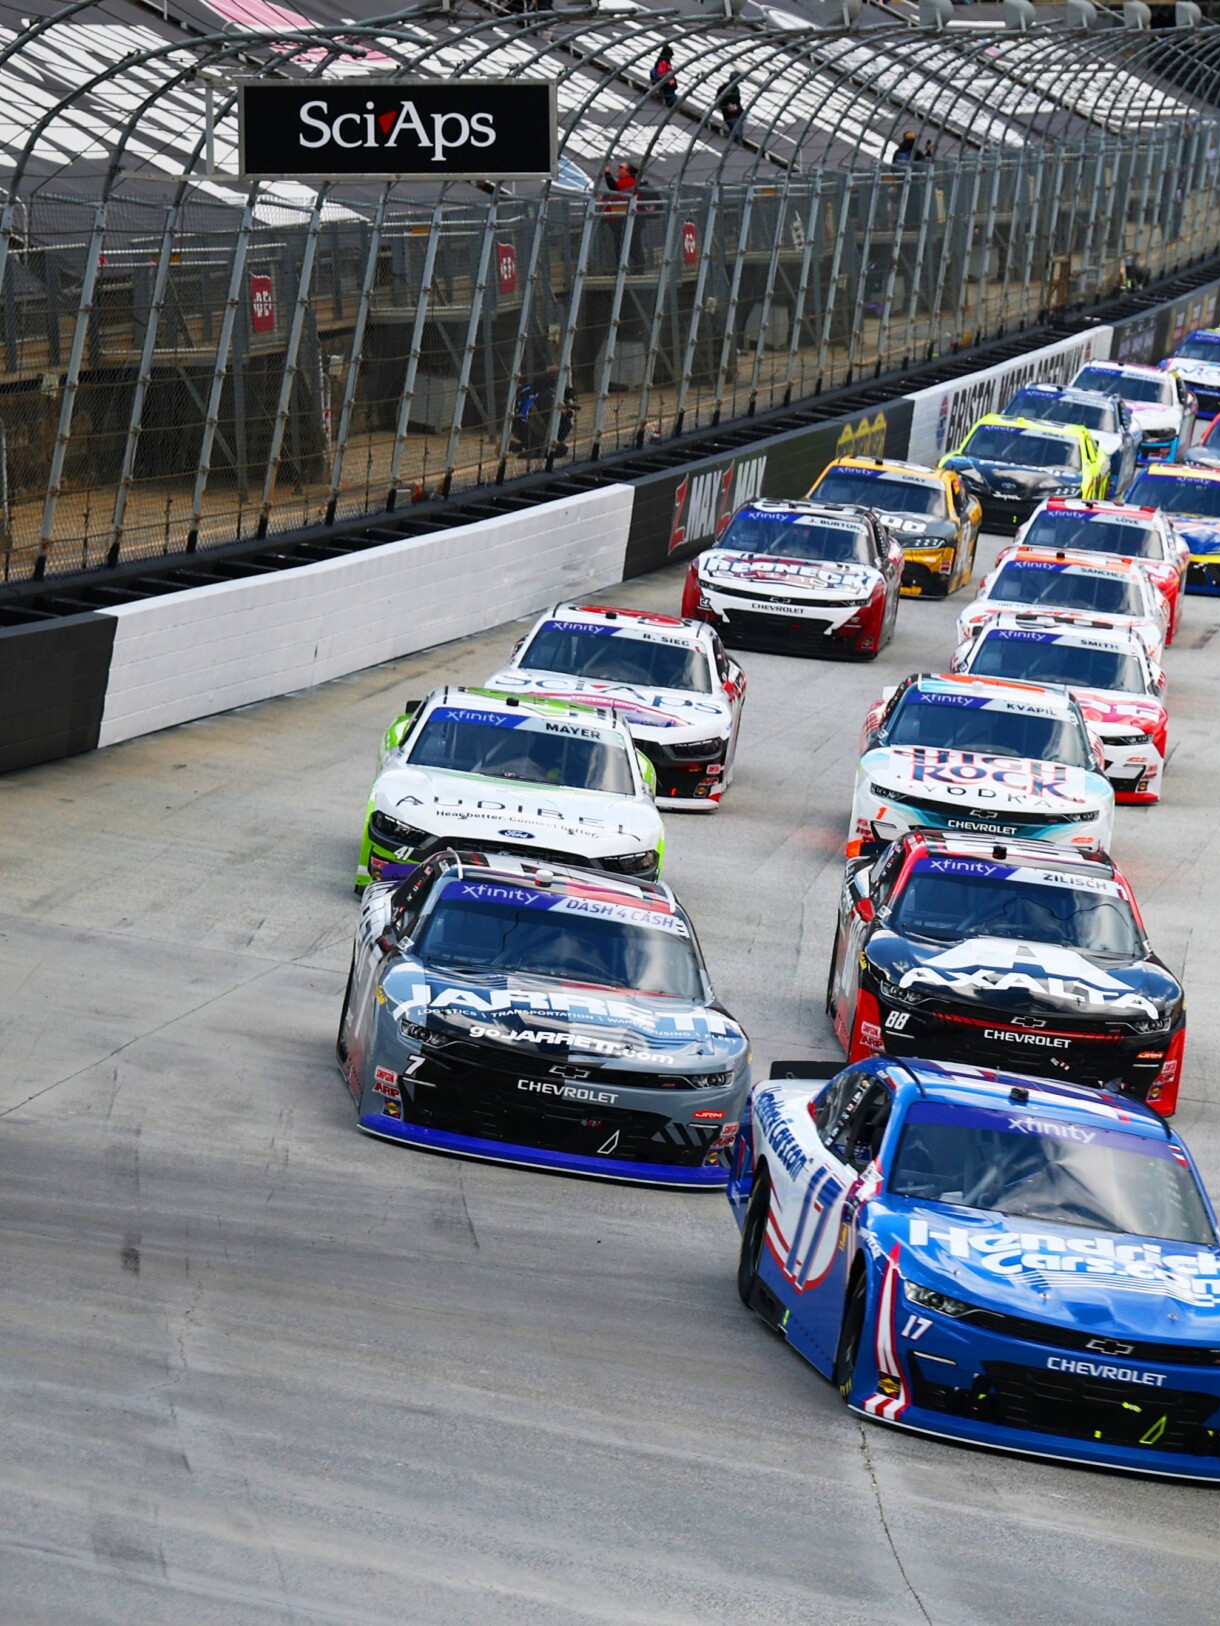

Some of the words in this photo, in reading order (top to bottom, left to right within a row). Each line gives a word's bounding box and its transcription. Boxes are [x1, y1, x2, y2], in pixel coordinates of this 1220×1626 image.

[299, 100, 497, 162] SciAps
[748, 512, 790, 522] xfinity
[1047, 510, 1086, 519] xfinity
[1115, 516, 1140, 526] LOVE
[1014, 561, 1057, 571] xfinity
[1080, 567, 1126, 579] SANCHEZ
[751, 603, 805, 615] CHEVROLET
[552, 620, 604, 635] xfinity
[642, 633, 655, 642] R.
[998, 629, 1047, 642] xfinity
[1080, 638, 1119, 651] SMITH
[921, 692, 974, 707] xfinity
[1006, 702, 1057, 717] KVAPIL
[445, 709, 508, 727] xfinity
[545, 722, 601, 740] MAYER
[875, 806, 888, 820] 1
[504, 829, 529, 840] Ford
[947, 819, 1018, 836] CHEVROLET
[394, 846, 414, 860] 41
[930, 859, 997, 876] xfinity
[1043, 872, 1107, 891] ZILISCH
[462, 884, 540, 905] xfinity
[566, 898, 613, 915] DASH
[616, 908, 627, 918] 4
[630, 910, 674, 929] CASH
[899, 967, 1159, 1020] AXALTA
[490, 1012, 594, 1021] TRANSPORTATION
[704, 1034, 738, 1045] FLEET
[885, 1010, 910, 1030] 88
[984, 1029, 1072, 1049] CHEVROLET
[405, 1055, 426, 1075] 7
[373, 1083, 400, 1097] ARP
[518, 1079, 619, 1104] CHEVROLET
[1007, 1117, 1097, 1143] xfinity
[901, 1315, 933, 1340] 17
[1047, 1356, 1167, 1387] CHEVROLET
